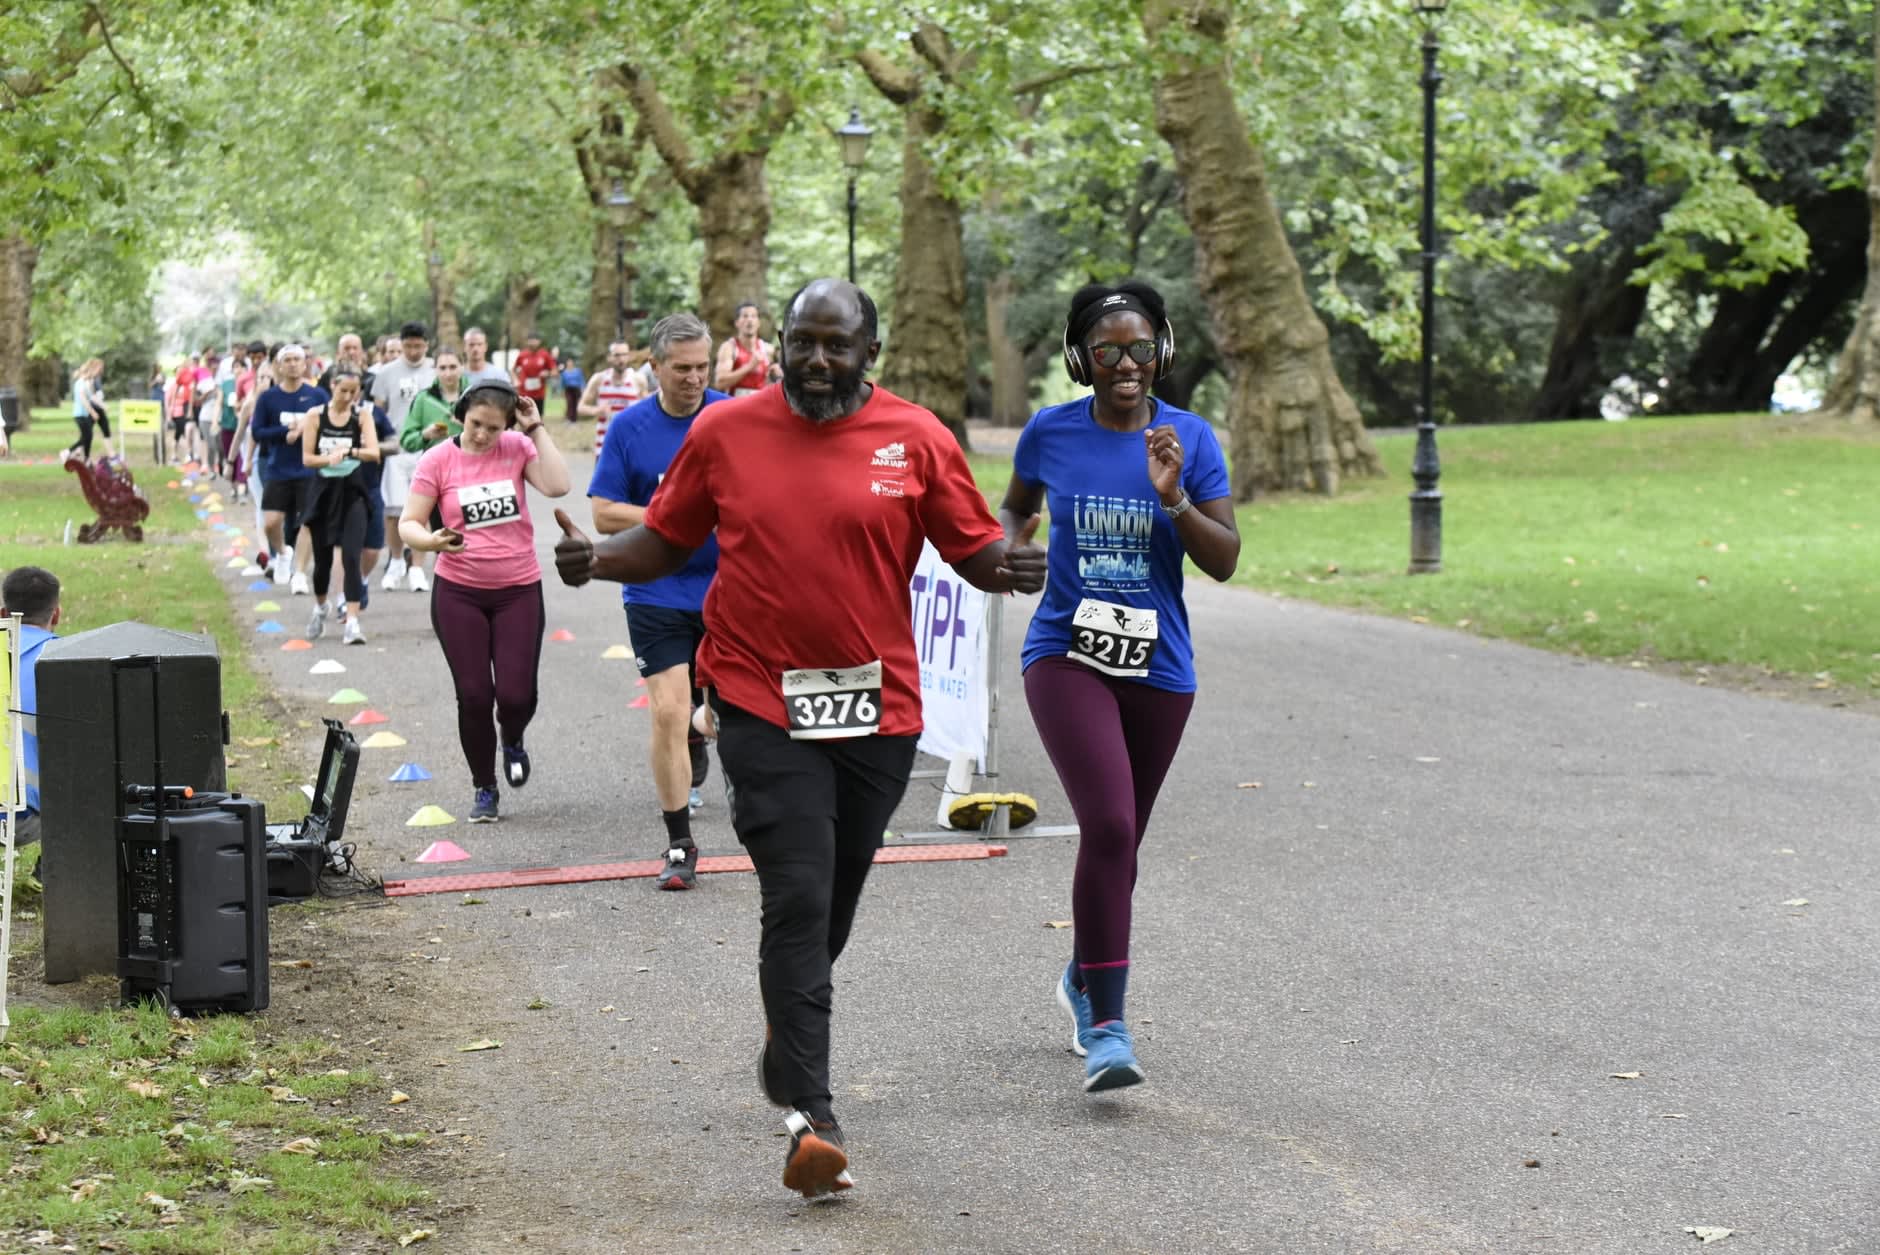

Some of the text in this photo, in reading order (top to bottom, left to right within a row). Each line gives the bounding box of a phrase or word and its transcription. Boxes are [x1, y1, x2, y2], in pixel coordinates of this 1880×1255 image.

[871, 457, 908, 469] JANUARY
[467, 496, 515, 522] 3295
[1074, 494, 1154, 548] LONDON
[1078, 630, 1150, 666] 3215
[794, 691, 877, 727] 3276
